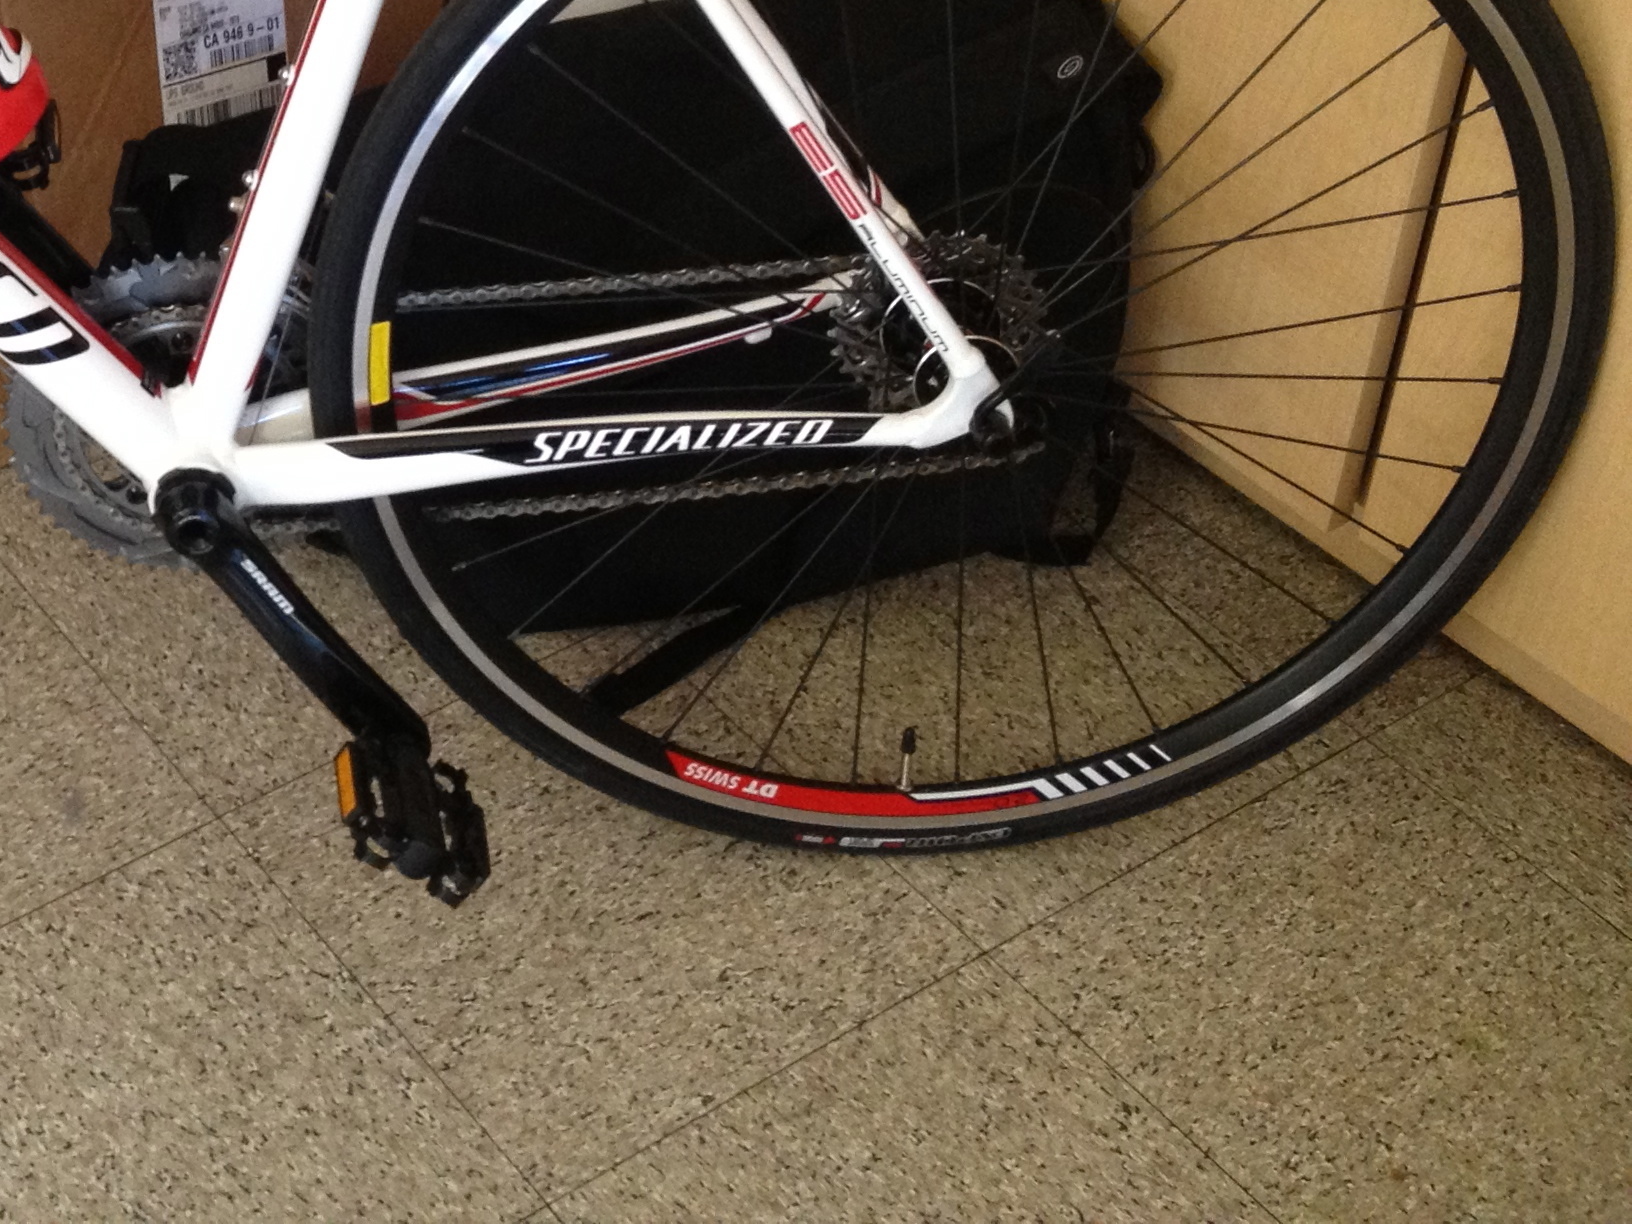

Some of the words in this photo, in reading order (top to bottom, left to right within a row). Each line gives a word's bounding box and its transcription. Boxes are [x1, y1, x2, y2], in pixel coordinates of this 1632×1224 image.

[203, 32, 220, 49] CA
[523, 418, 834, 464] SPECIALIZED
[240, 557, 295, 615] SRAM
[683, 762, 741, 790] SWISS
[741, 778, 780, 798] DT
